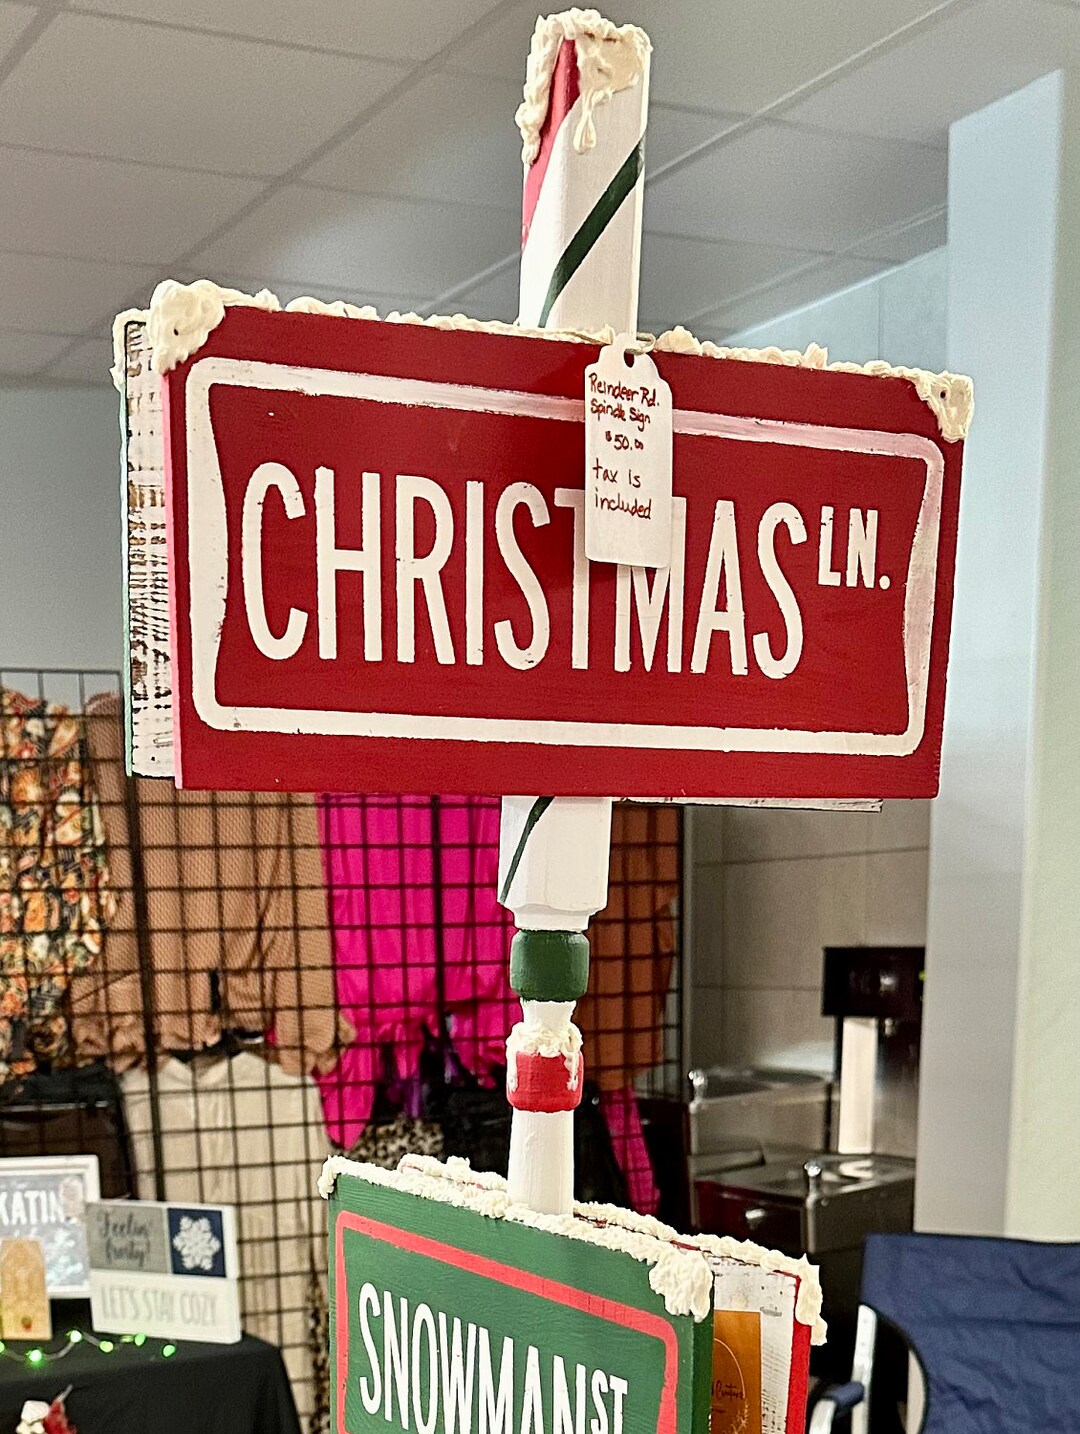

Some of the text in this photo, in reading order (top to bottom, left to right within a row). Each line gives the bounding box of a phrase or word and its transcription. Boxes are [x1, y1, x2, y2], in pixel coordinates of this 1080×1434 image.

[588, 373, 638, 401] Reindeer
[629, 406, 651, 432] Sign
[592, 458, 641, 489] tax is
[594, 487, 652, 520] included
[242, 461, 891, 680] CHRISTMAS LN.
[101, 1284, 140, 1322] LET'S
[180, 1292, 216, 1328] COZY
